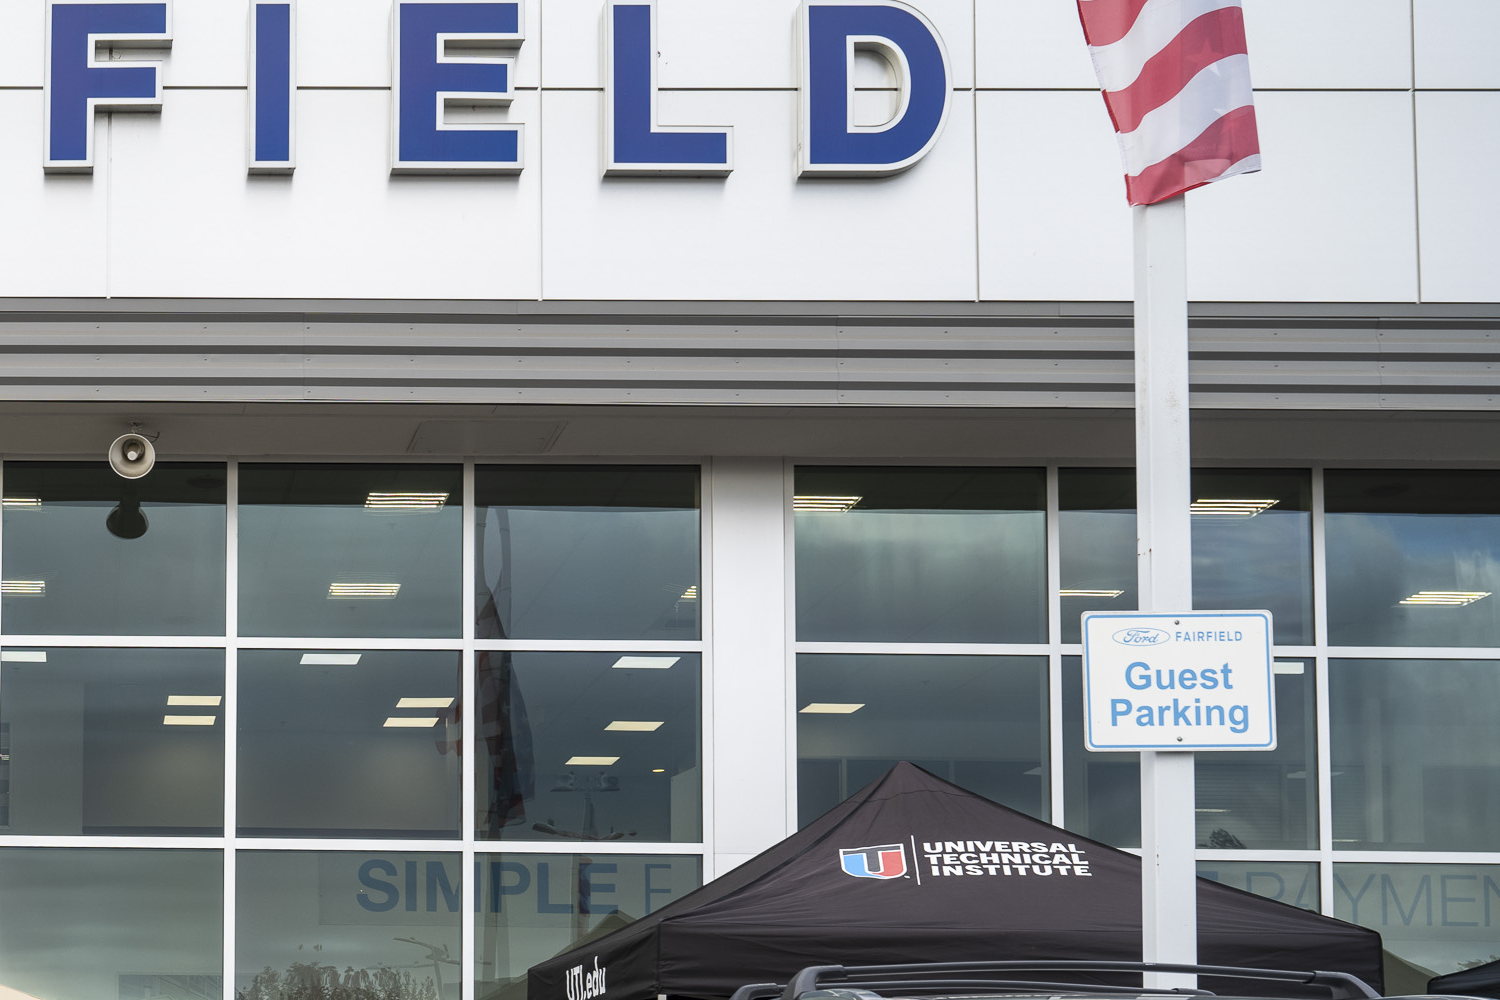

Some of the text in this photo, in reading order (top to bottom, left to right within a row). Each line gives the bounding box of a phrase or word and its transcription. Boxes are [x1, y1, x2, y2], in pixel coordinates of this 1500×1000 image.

[1123, 629, 1243, 644] Ford FAIRFIELD
[1125, 661, 1234, 690] Guest
[1111, 698, 1250, 734] Parking
[922, 840, 1086, 854] UNIVERSAL
[923, 853, 1089, 865] TECHNICAL
[931, 864, 1093, 876] INSTITUTE
[356, 858, 619, 914] SIMPLE
